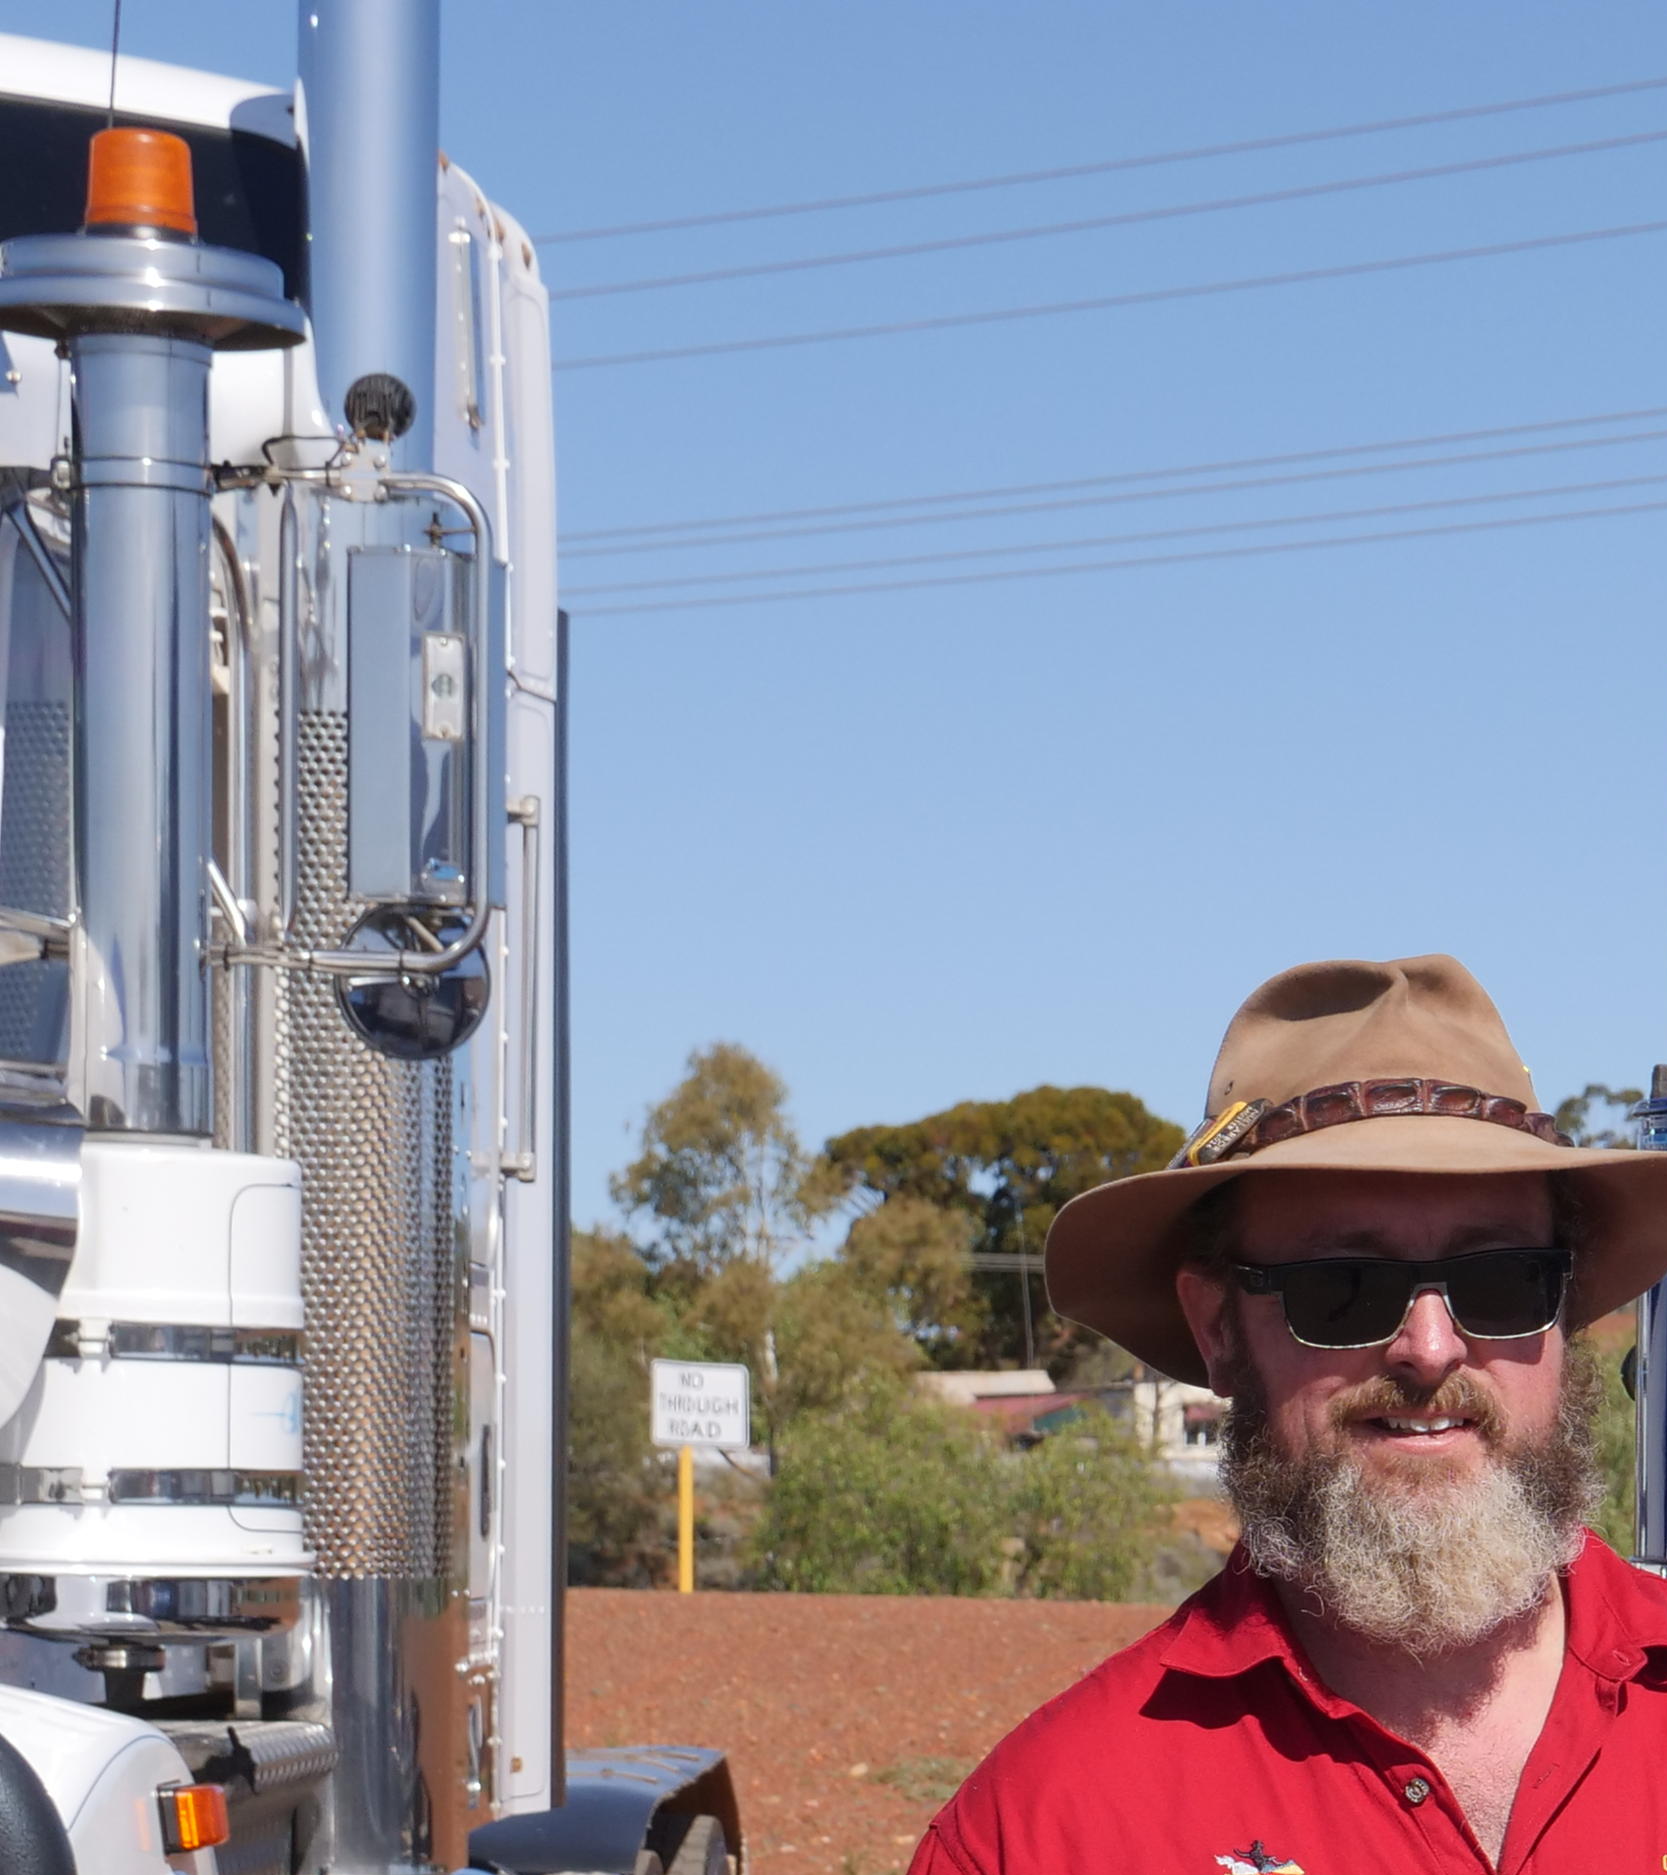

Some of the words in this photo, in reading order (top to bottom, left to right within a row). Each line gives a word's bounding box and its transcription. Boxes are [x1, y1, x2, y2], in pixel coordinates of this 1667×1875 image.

[680, 1372, 704, 1388] NO
[660, 1392, 739, 1415] THROUGH
[669, 1420, 721, 1438] ROAD
